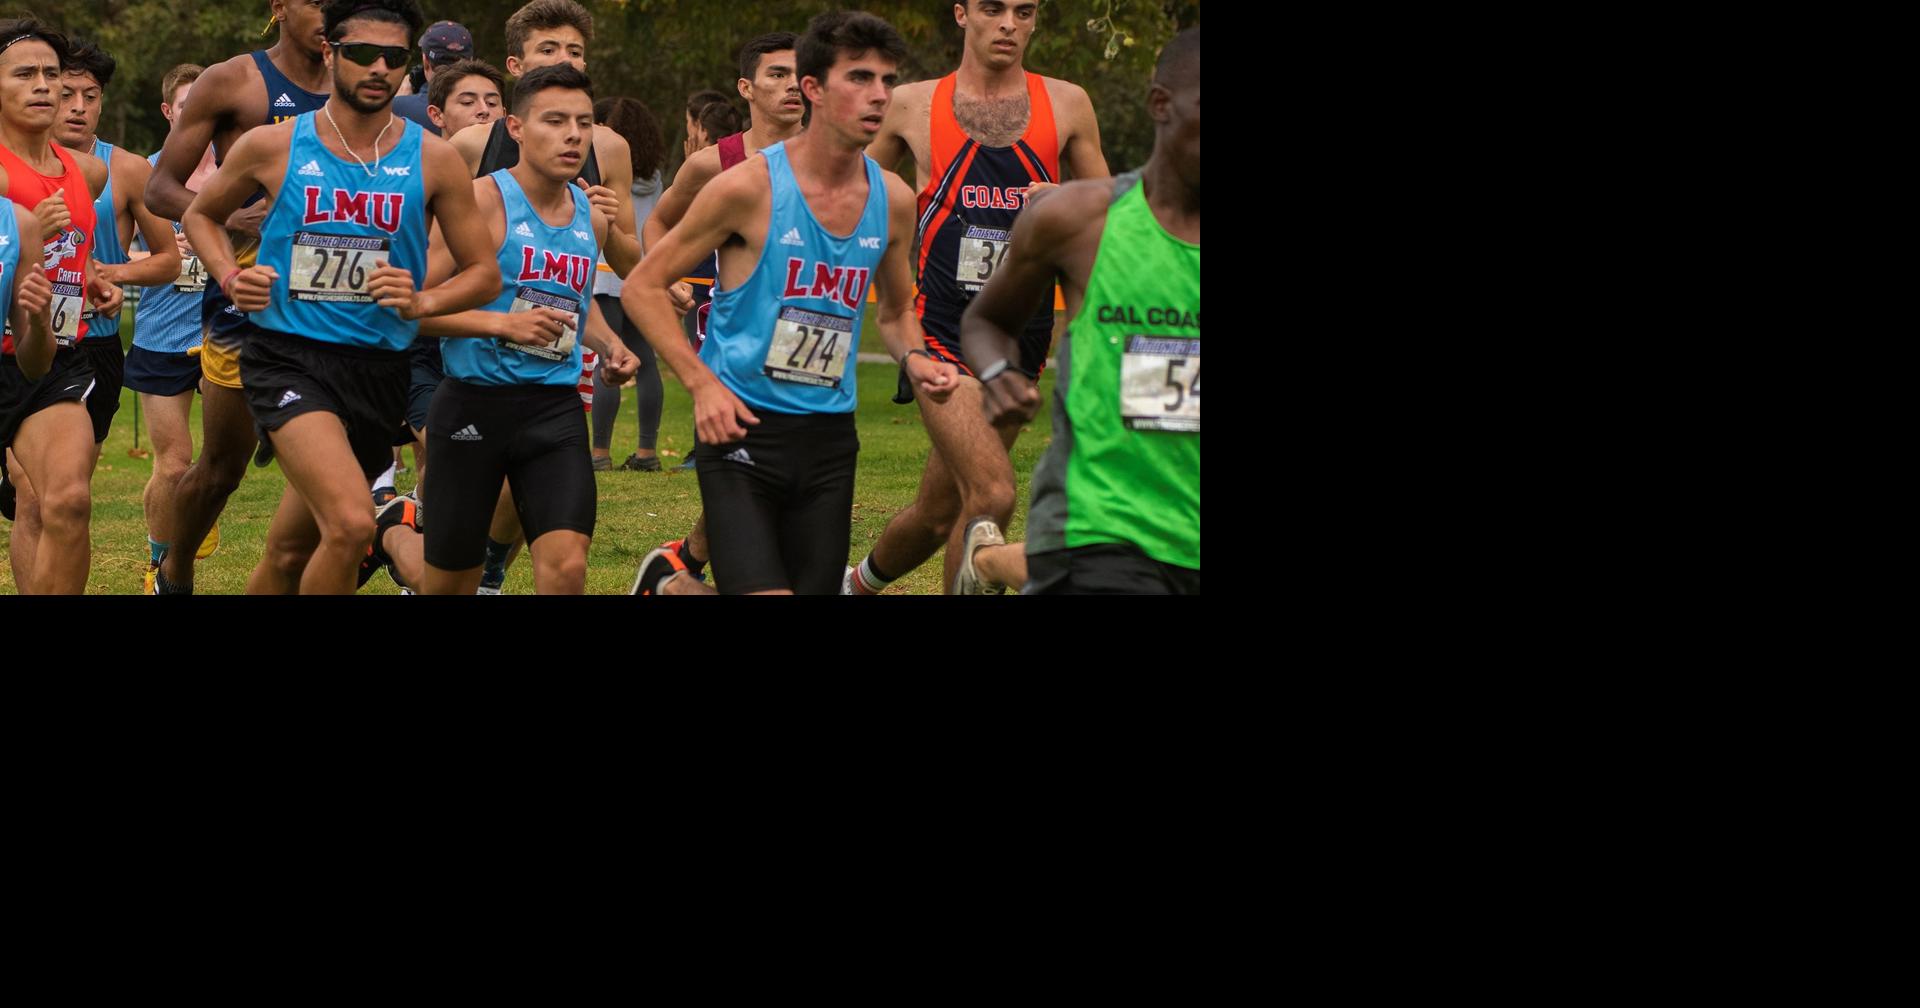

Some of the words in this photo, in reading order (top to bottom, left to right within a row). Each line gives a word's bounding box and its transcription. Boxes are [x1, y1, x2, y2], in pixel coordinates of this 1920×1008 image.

[302, 186, 405, 234] LMU
[310, 249, 365, 290] 276
[518, 245, 591, 294] LMU
[783, 257, 870, 312] LMU
[1098, 305, 1143, 325] CAL
[787, 326, 838, 372] 274
